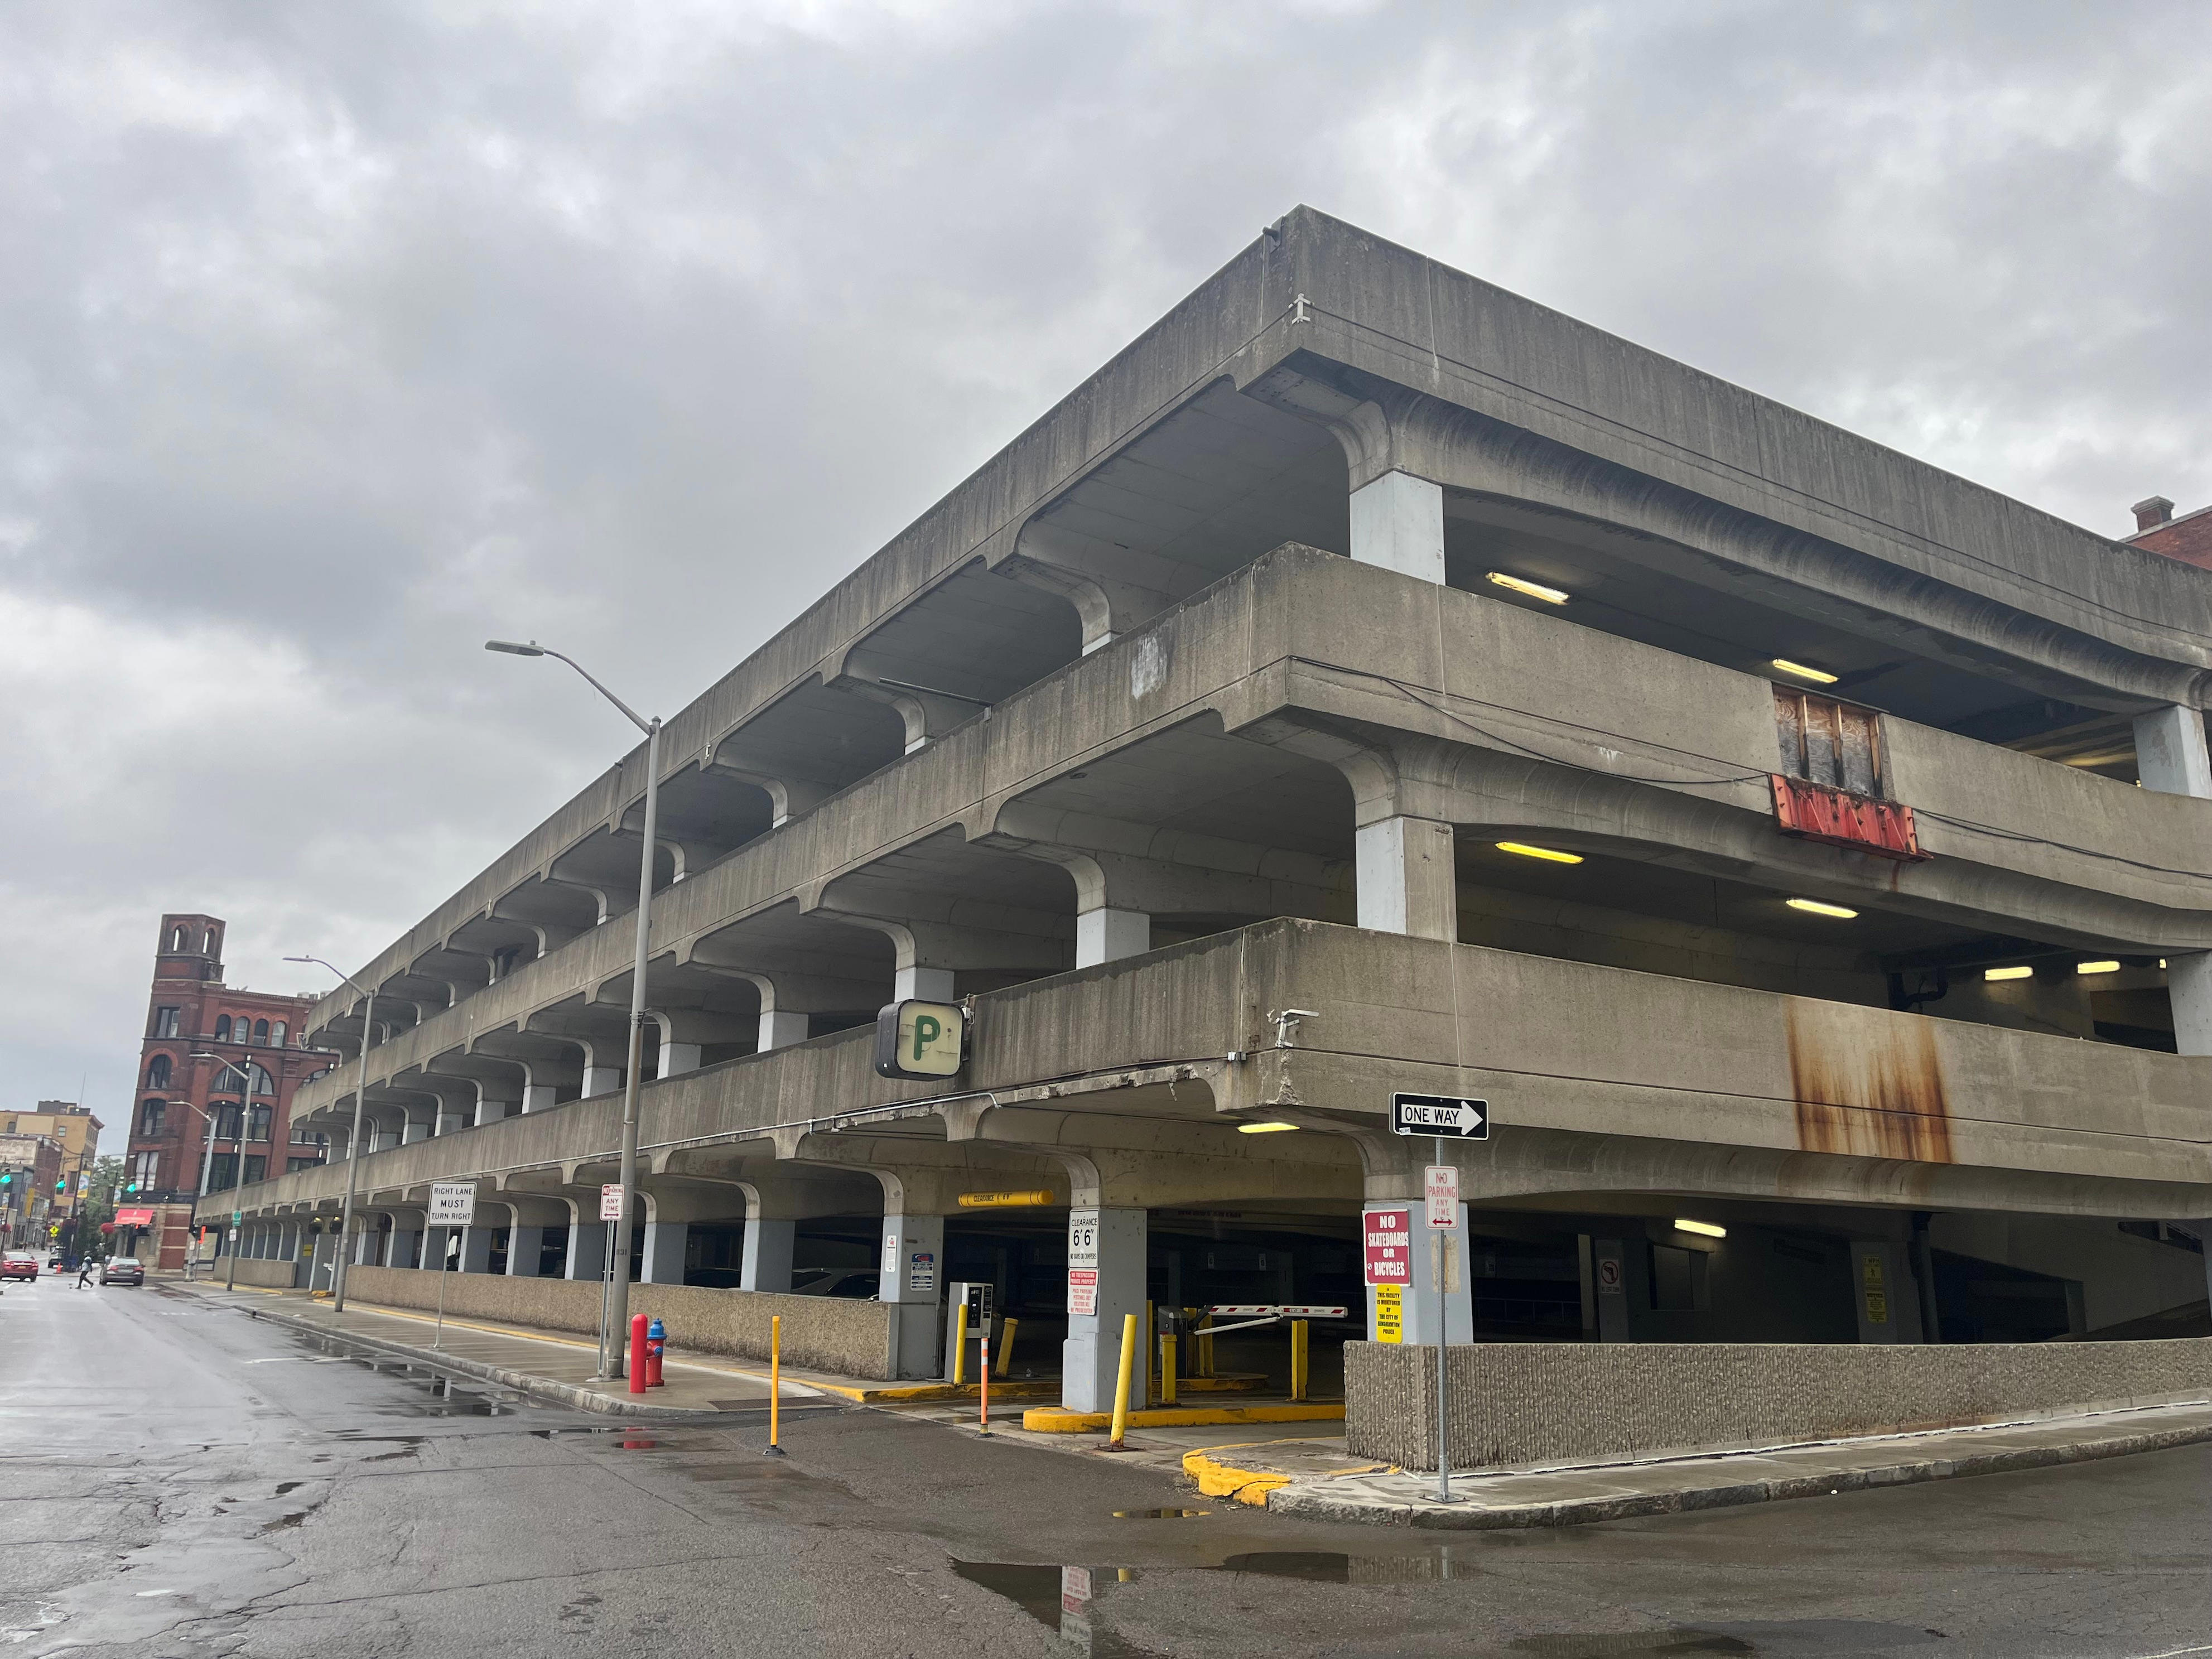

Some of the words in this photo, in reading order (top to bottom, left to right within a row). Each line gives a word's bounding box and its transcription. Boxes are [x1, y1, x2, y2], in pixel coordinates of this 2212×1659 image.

[913, 1015, 941, 1061] P
[1405, 1107, 1429, 1123] ONE
[1434, 1108, 1459, 1125] WAY
[1435, 1172, 1448, 1184] NO
[1428, 1186, 1456, 1198] PARKING
[440, 1200, 465, 1208] MUST
[1434, 1208, 1450, 1216] TIME
[1071, 1218, 1097, 1227] CLEARANCE
[1379, 1215, 1396, 1228] NO
[1368, 1232, 1409, 1247] SKATEBOARDS
[1382, 1248, 1395, 1258] OR
[1374, 1261, 1405, 1276] BICYCLES
